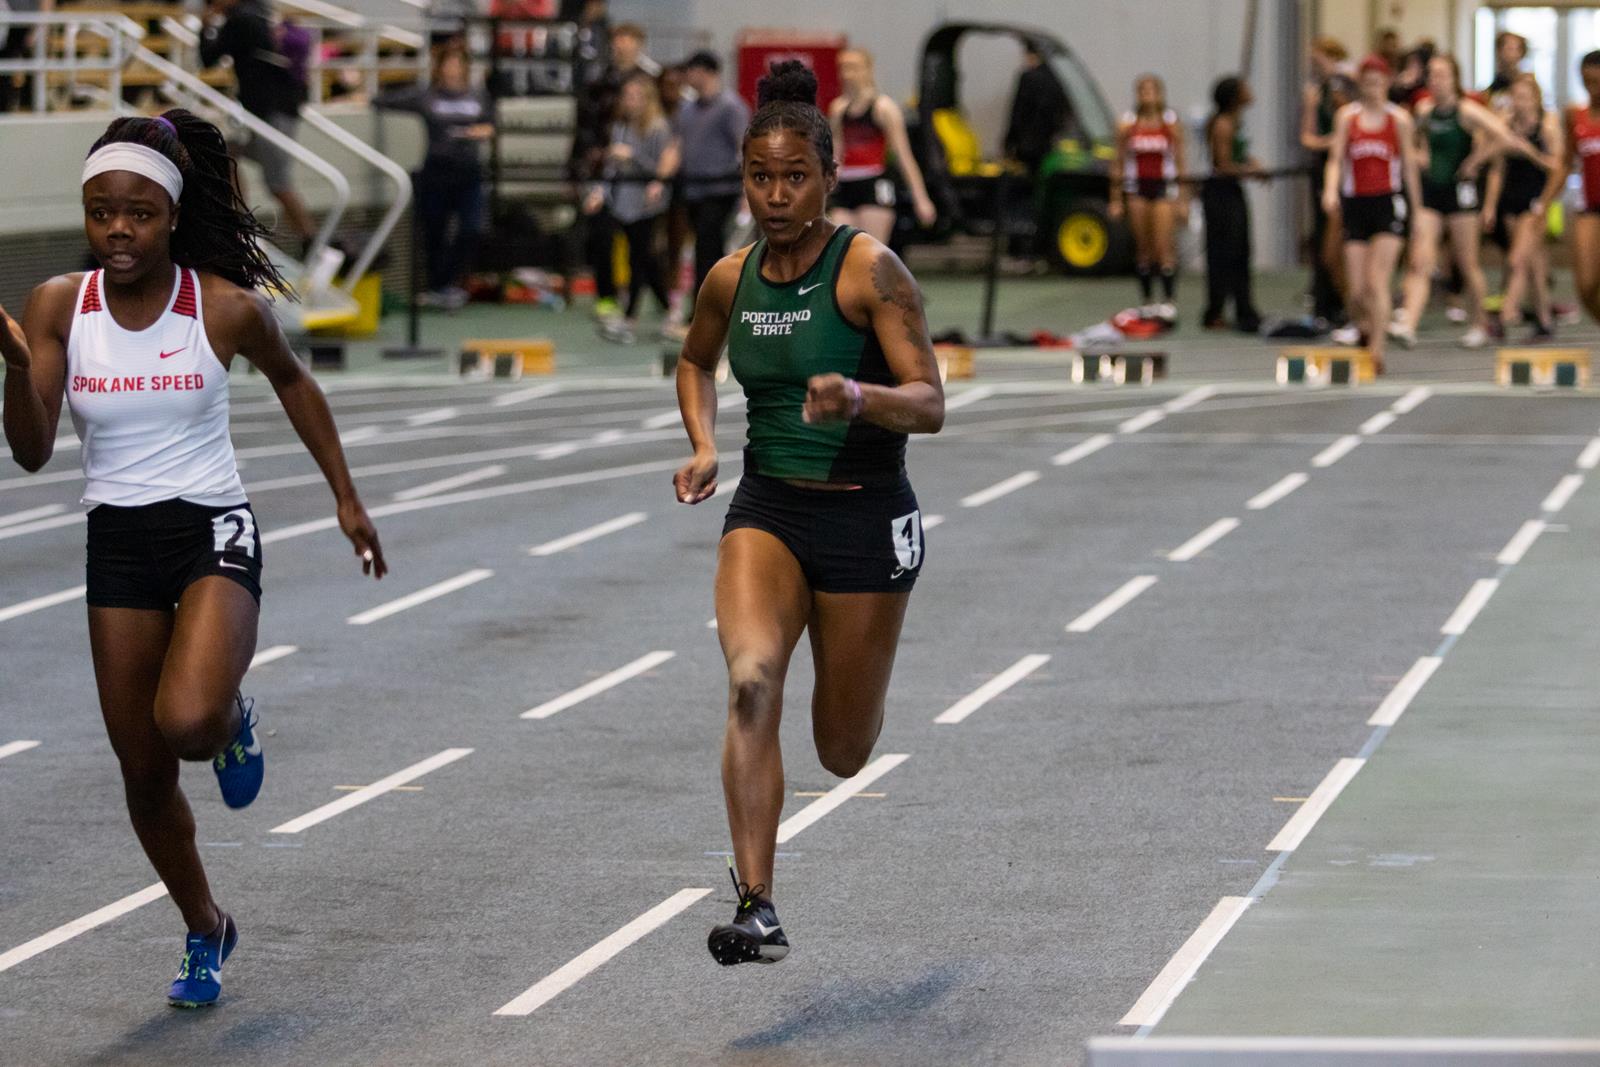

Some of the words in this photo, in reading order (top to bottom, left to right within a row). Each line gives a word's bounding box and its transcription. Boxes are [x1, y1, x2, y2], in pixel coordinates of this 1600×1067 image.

[740, 309, 812, 324] PORTLAND
[752, 323, 793, 336] STATE
[72, 375, 146, 393] SPOKANE
[151, 374, 204, 391] SPEED
[223, 513, 249, 556] 2
